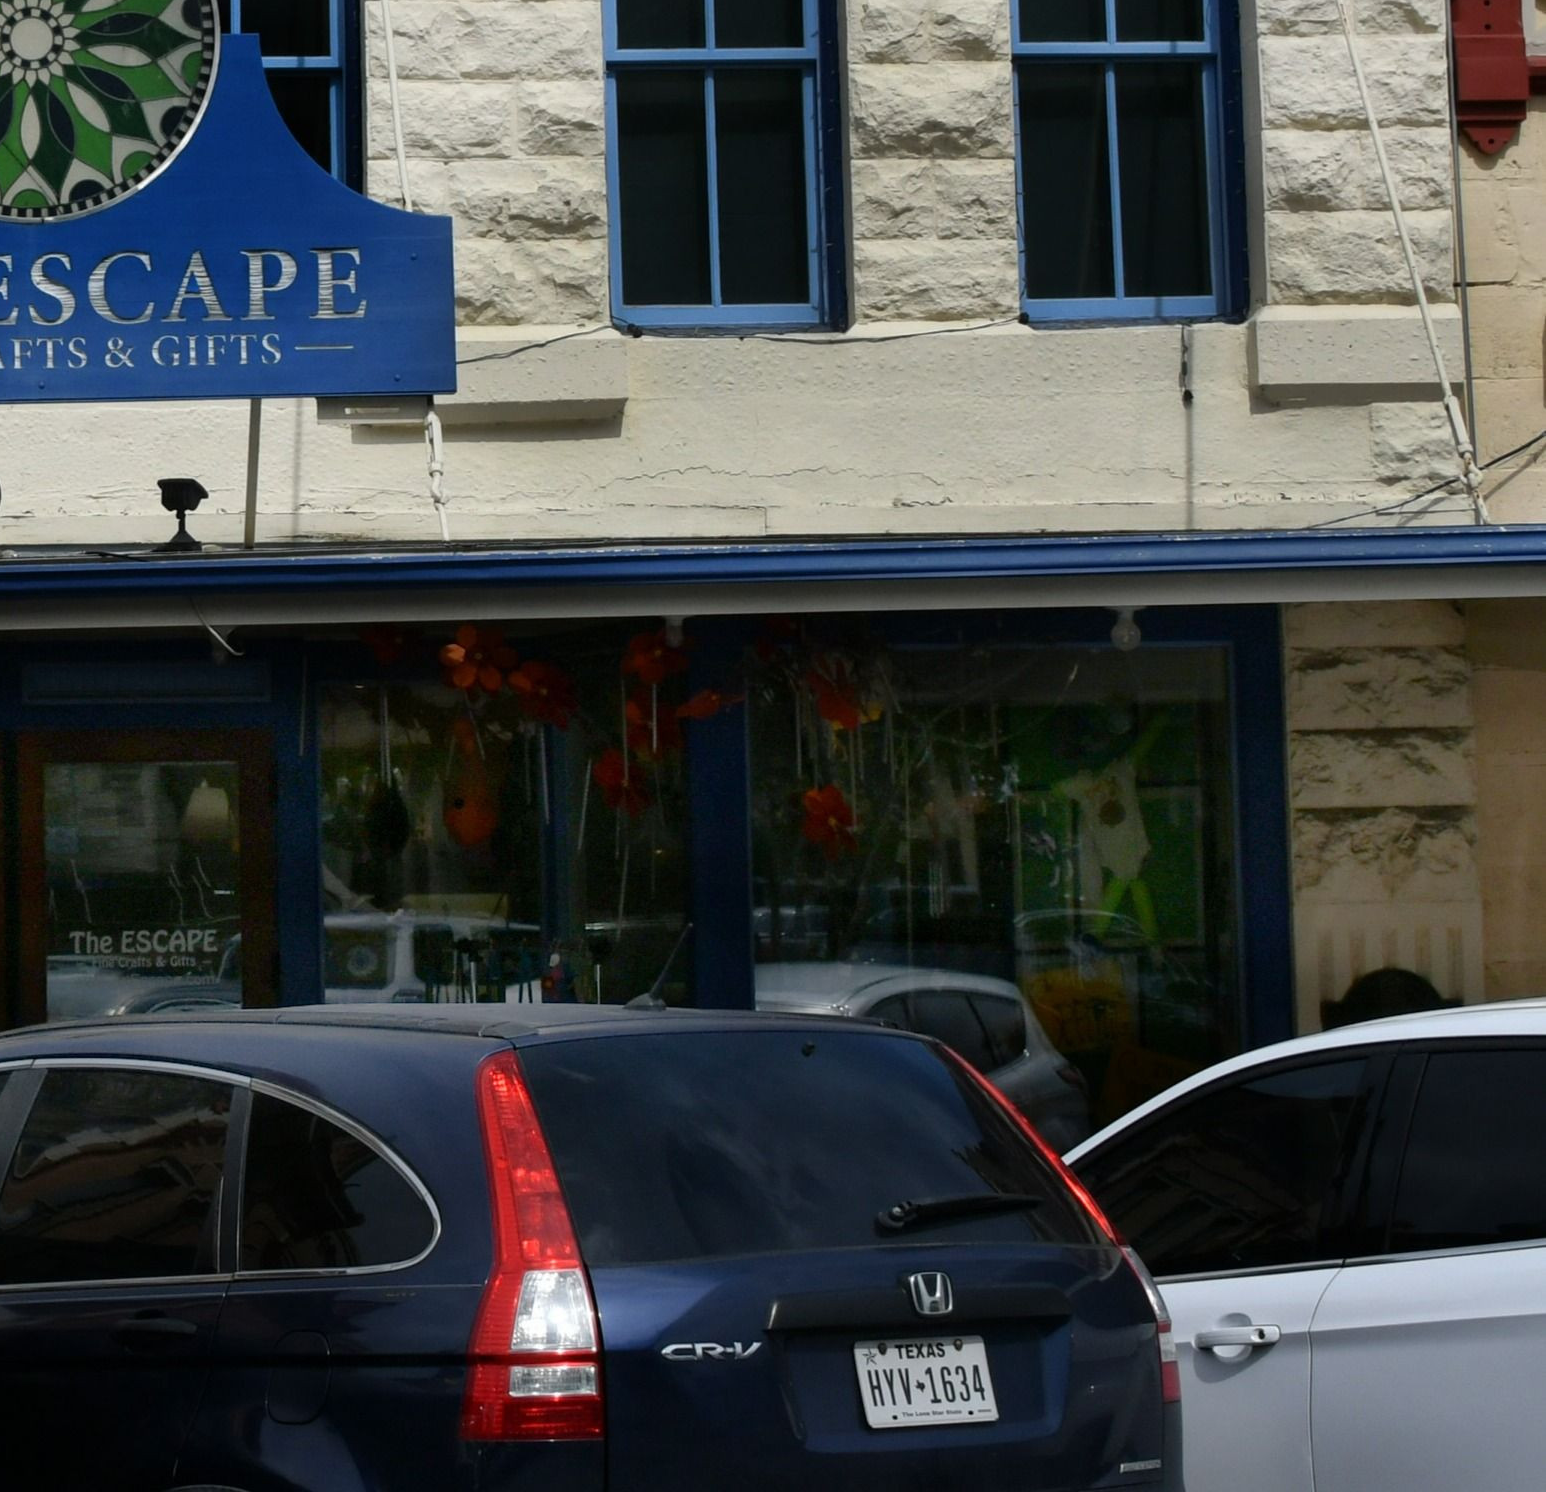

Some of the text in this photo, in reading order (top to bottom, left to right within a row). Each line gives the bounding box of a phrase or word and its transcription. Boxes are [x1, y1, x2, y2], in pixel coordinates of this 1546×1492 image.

[104, 337, 135, 369] &
[151, 333, 282, 367] GIFTS
[69, 929, 218, 954] The ESCAPE
[661, 1342, 762, 1361] CR-V
[894, 1342, 946, 1360] TEXAS
